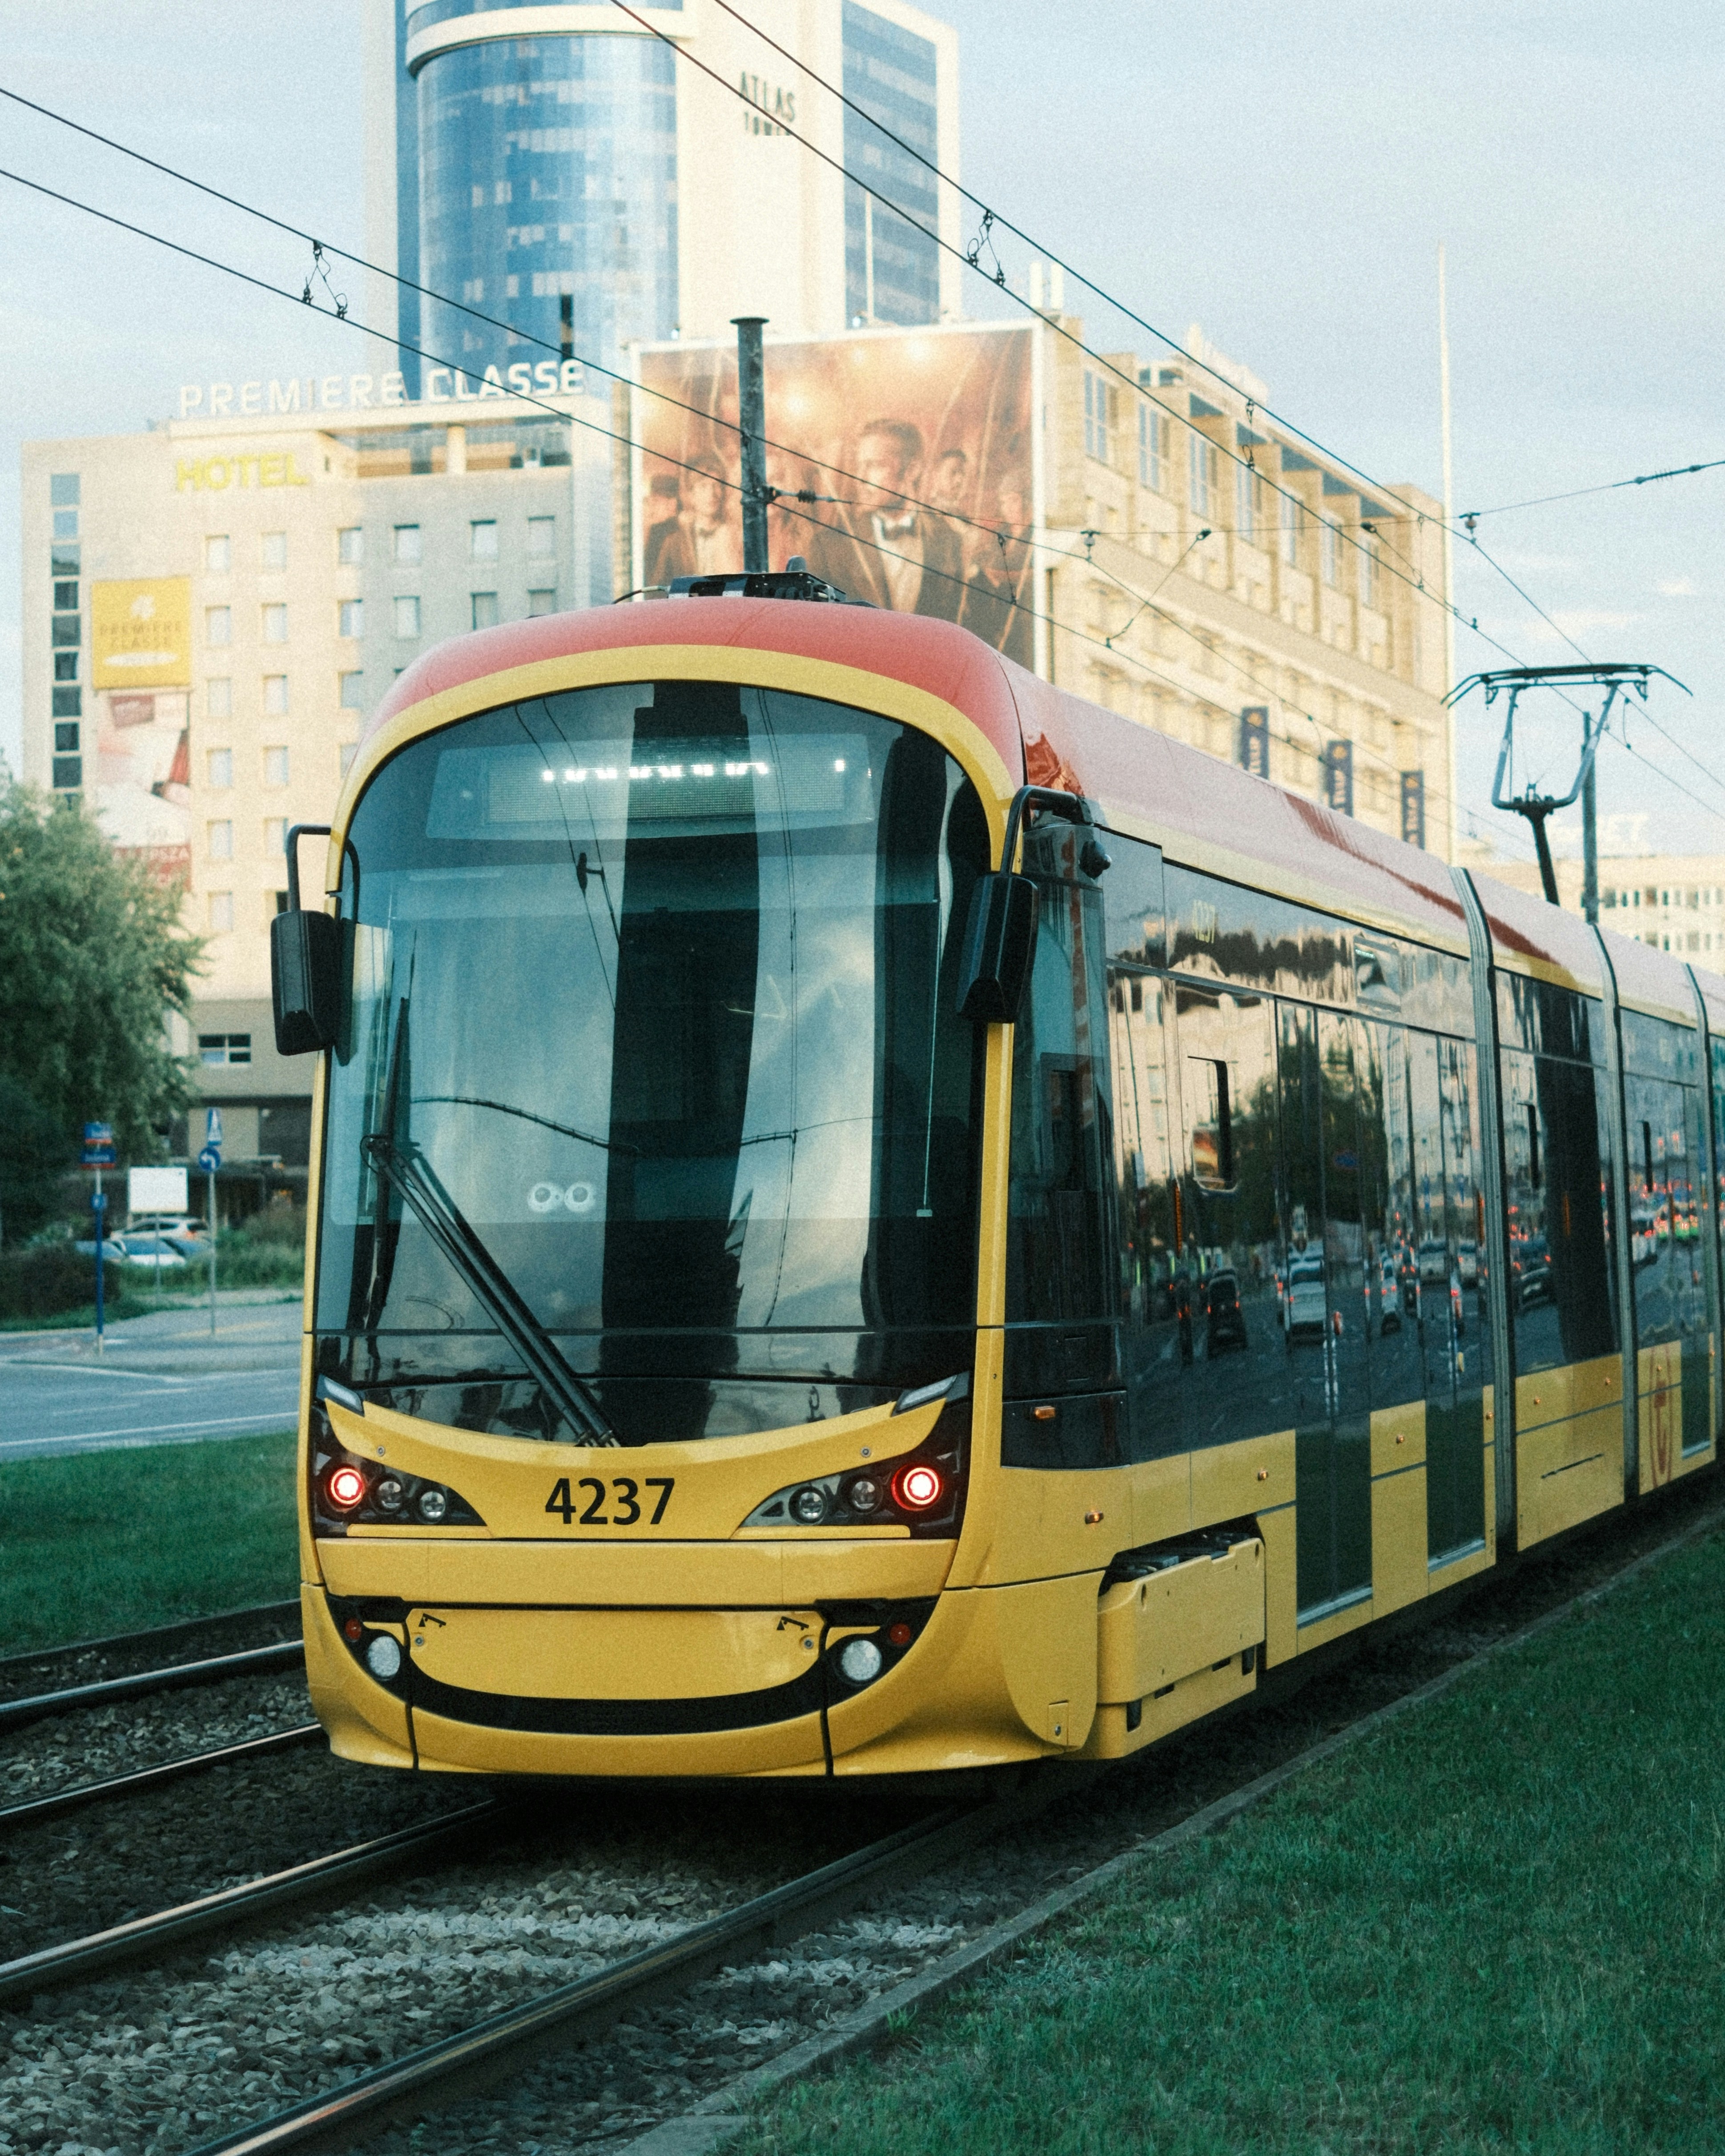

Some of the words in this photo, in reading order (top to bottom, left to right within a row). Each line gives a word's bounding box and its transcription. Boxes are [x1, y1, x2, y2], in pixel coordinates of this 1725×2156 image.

[740, 71, 795, 122] ATLAS
[179, 371, 404, 419] PREMIERE
[427, 358, 585, 402] CLASSE
[176, 453, 310, 492] HOTEL
[545, 1477, 675, 1525] 4237
